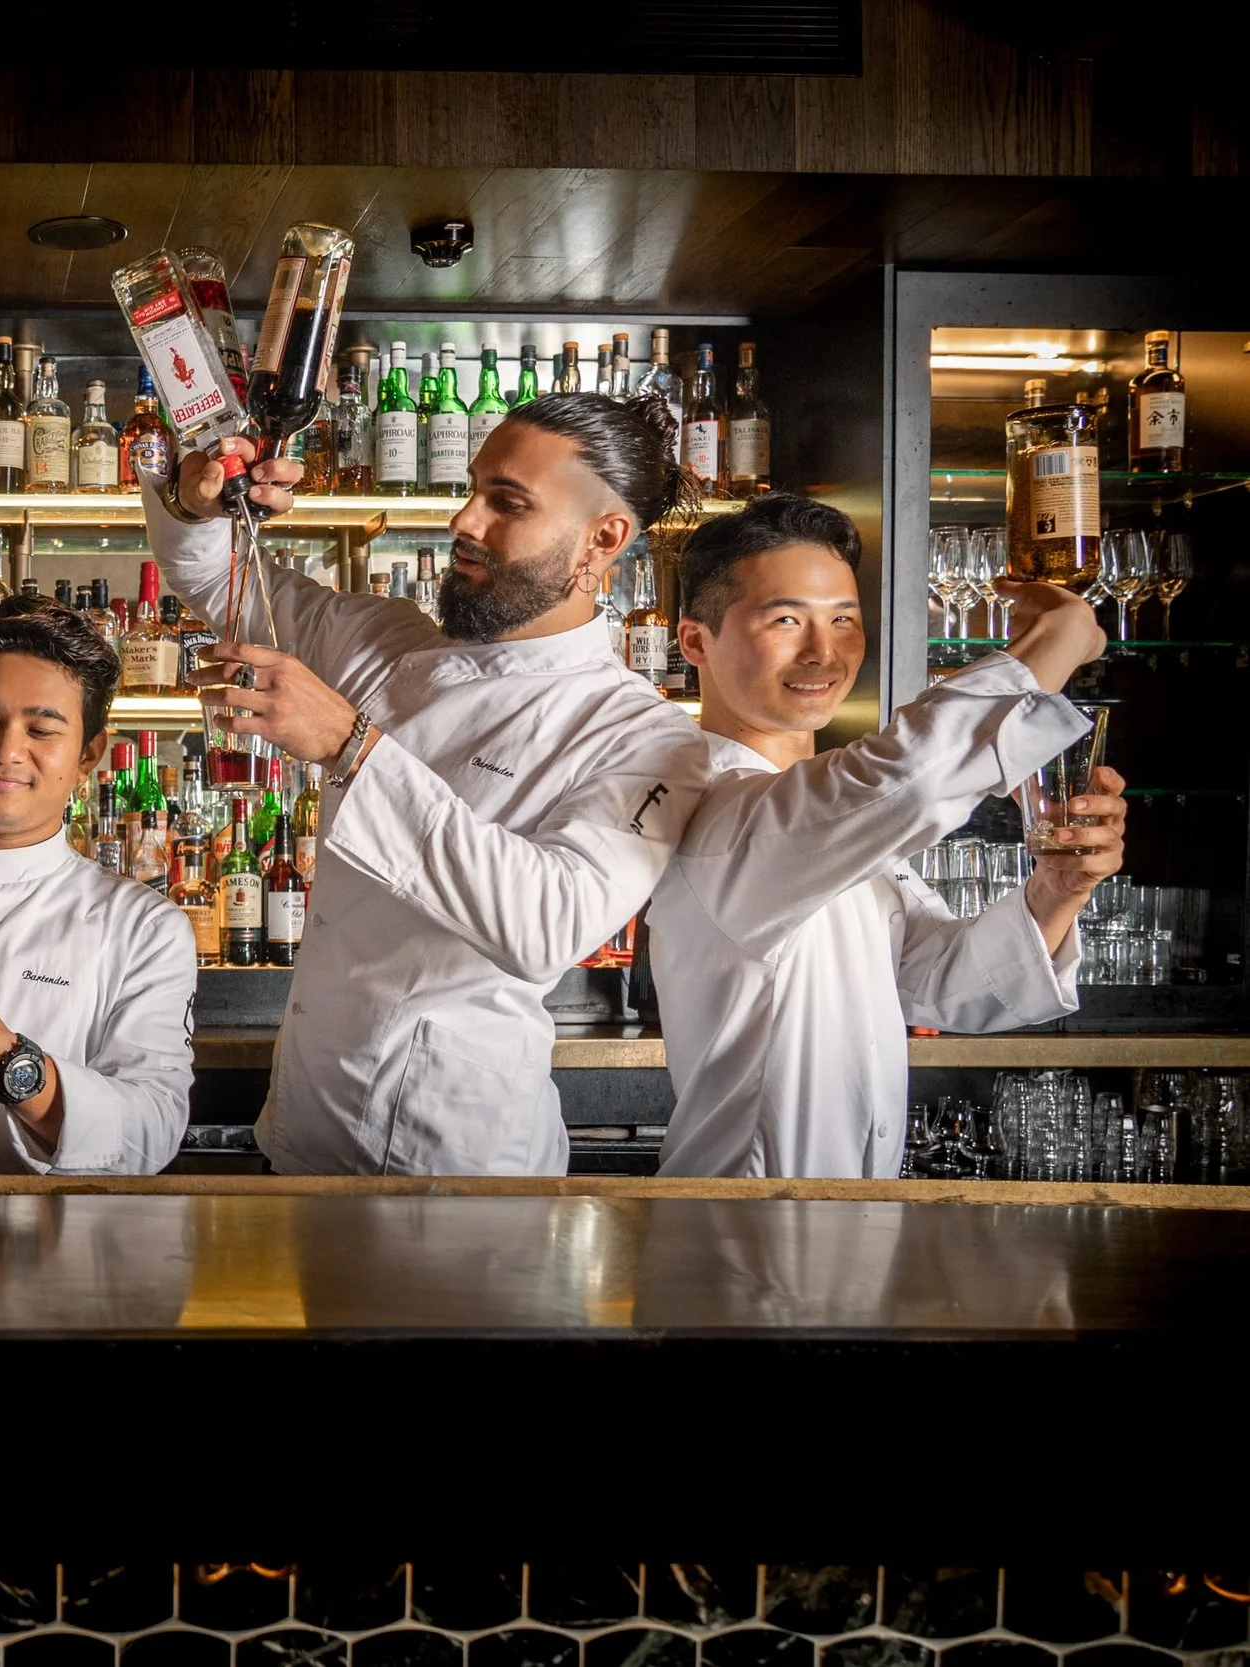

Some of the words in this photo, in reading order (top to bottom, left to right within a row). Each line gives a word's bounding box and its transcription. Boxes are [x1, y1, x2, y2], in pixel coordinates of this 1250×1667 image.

[182, 392, 206, 406] LONDON
[172, 389, 223, 423] BEEFEATER
[1146, 408, 1181, 426] 余市
[388, 448, 398, 457] 10
[698, 455, 706, 463] 10
[183, 637, 197, 649] JACK
[120, 646, 158, 654] Maker's
[130, 654, 157, 663] Mark
[471, 757, 515, 778] Bartender
[221, 878, 261, 889] JAMESON
[22, 969, 70, 987] Bartender
